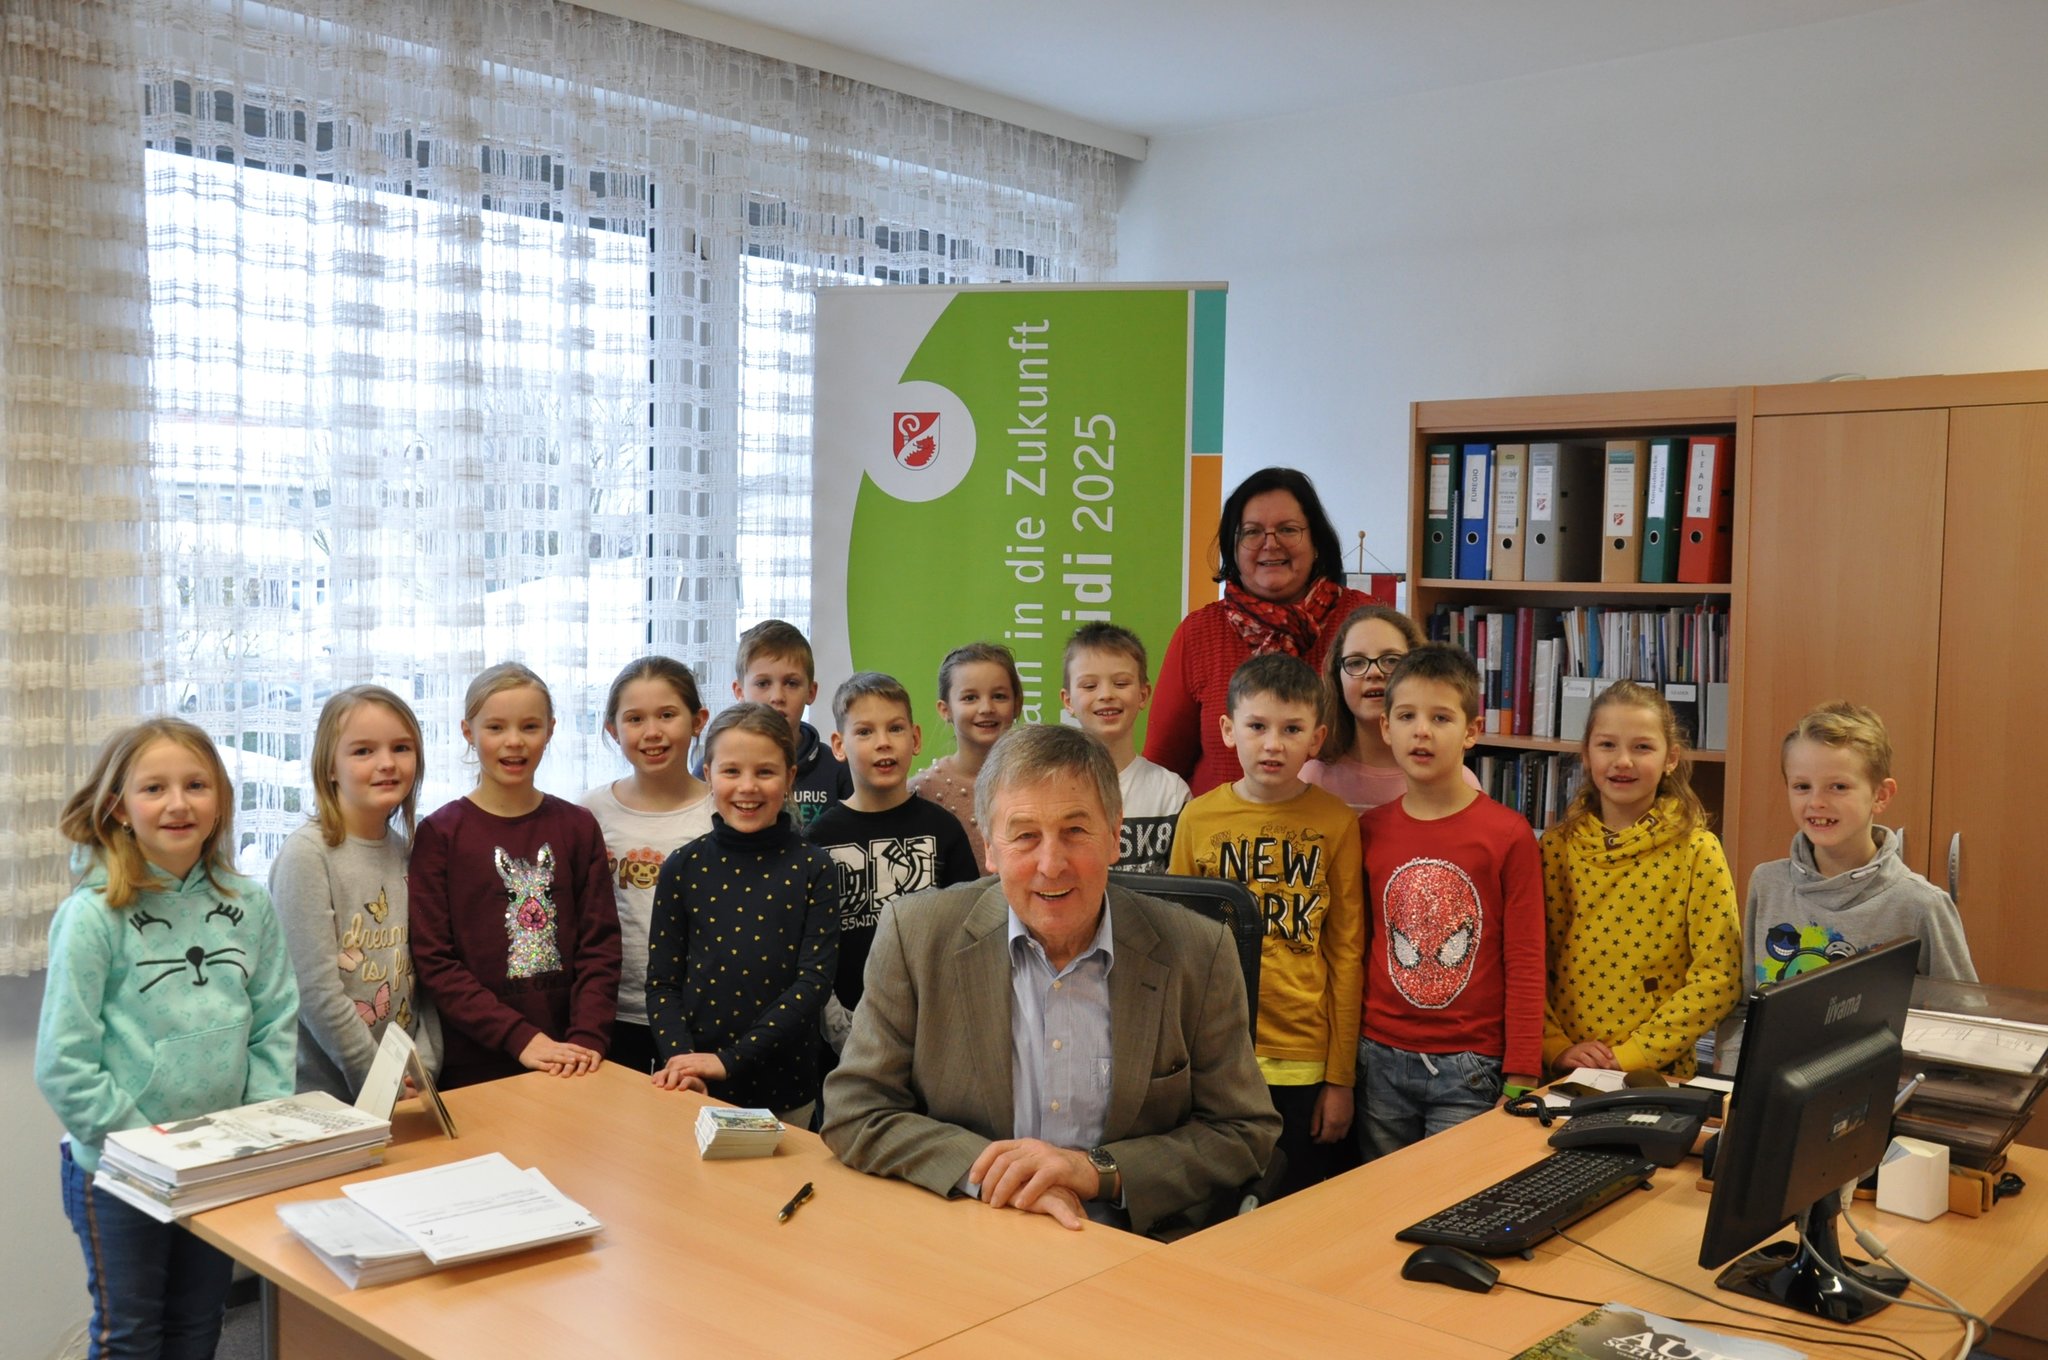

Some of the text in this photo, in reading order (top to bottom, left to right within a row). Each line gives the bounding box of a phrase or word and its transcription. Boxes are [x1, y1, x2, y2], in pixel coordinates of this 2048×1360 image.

[1471, 468, 1479, 502] EUREGIO
[1004, 319, 1050, 725] am in die Zukunft
[1061, 414, 1116, 632] idi 2025
[793, 790, 828, 804] URUS
[800, 804, 823, 816] EX
[1120, 822, 1173, 858] SK8
[1219, 837, 1321, 888] NEW
[840, 912, 881, 932] SSWIN
[1259, 892, 1321, 943] RK
[361, 955, 389, 983] is
[1611, 1331, 1744, 1360] AU
